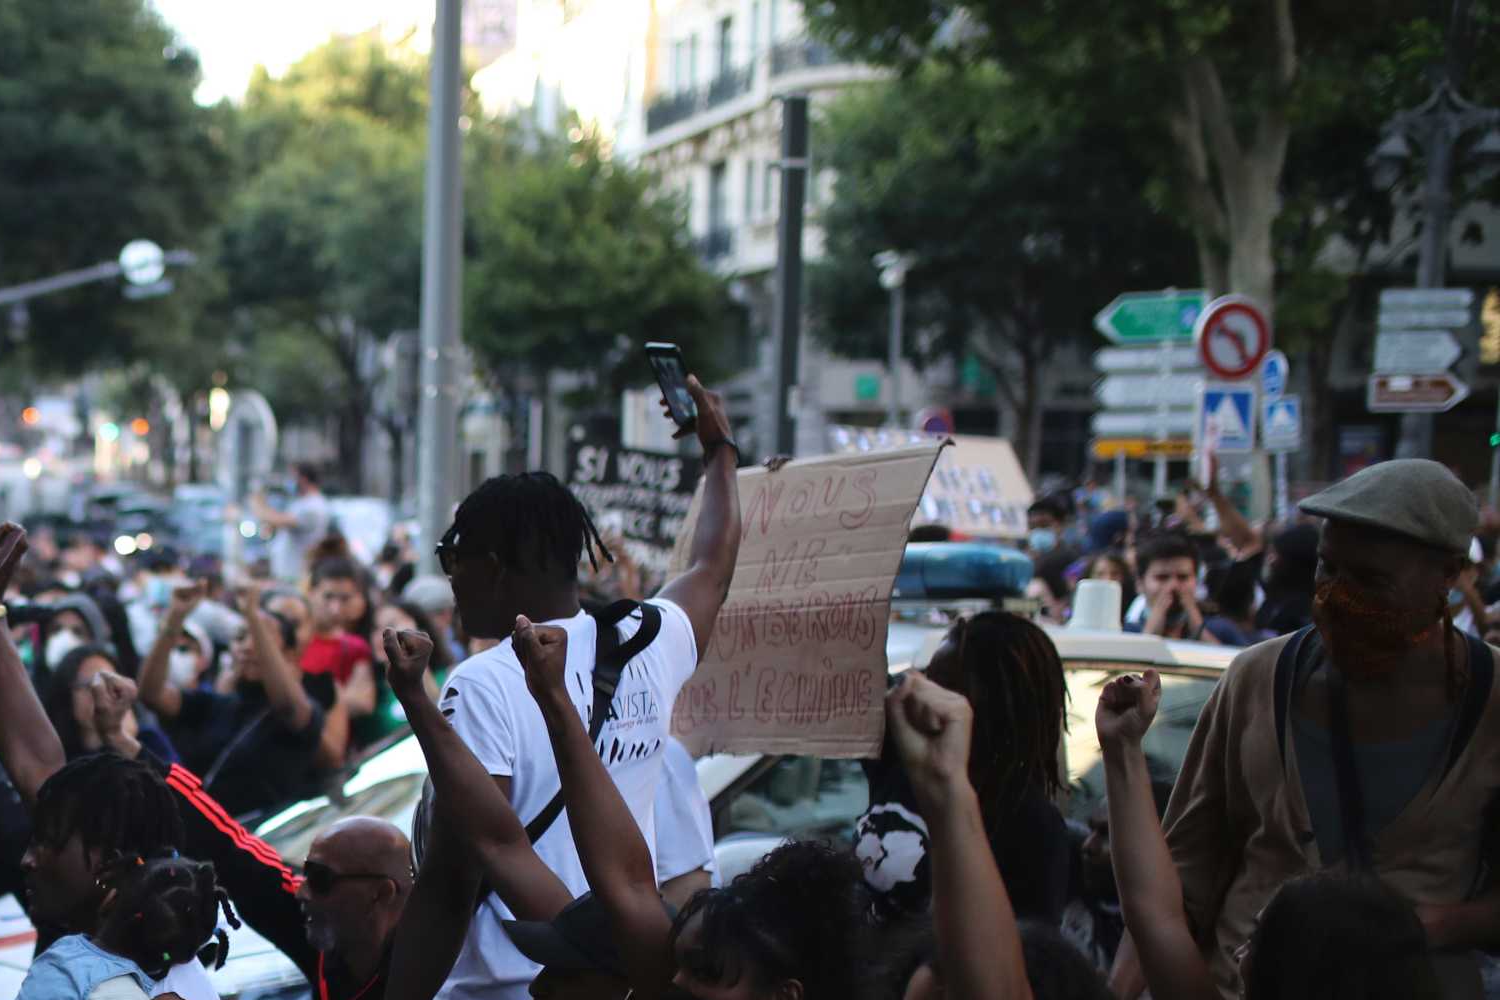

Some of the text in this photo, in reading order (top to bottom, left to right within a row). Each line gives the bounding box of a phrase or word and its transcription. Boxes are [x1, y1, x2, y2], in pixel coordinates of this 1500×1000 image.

[574, 445, 683, 492] SI VOUS
[743, 470, 877, 540] NOUS
